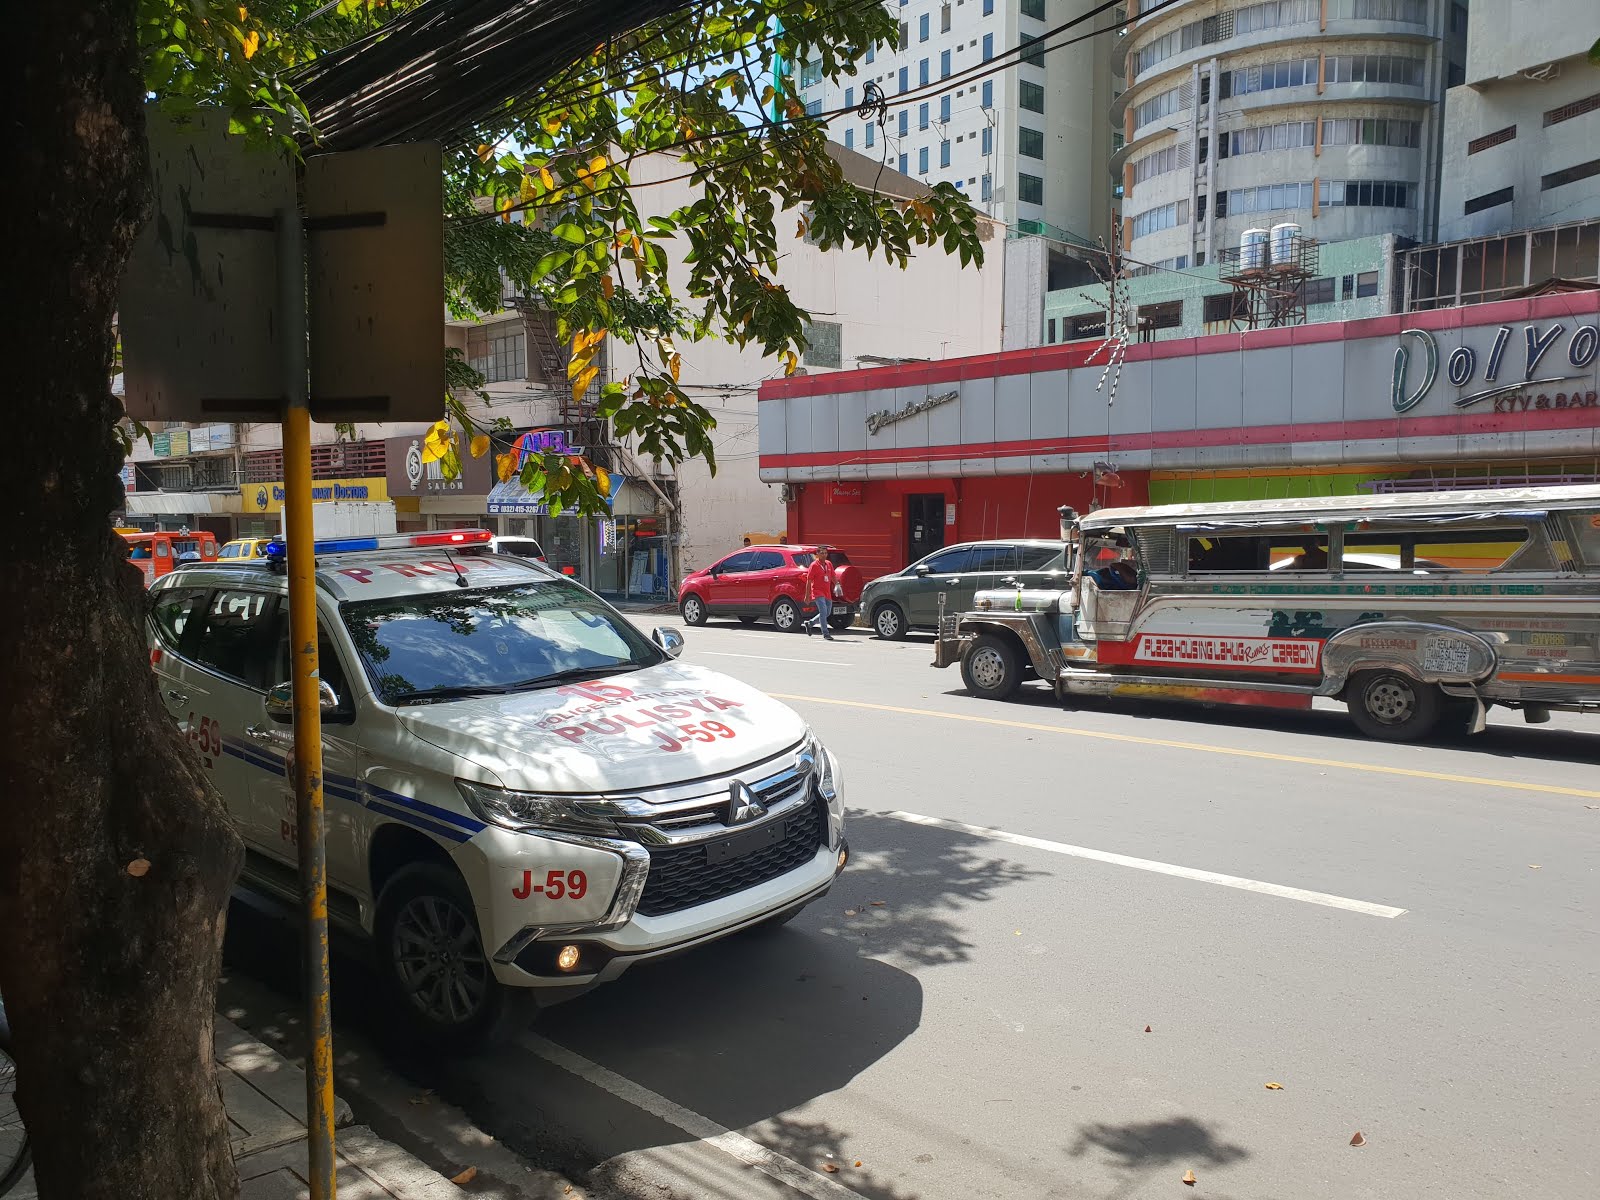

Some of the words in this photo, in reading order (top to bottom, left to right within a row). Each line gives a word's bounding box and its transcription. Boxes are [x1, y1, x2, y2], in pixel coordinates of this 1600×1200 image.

[1494, 395, 1532, 413] KTV
[1535, 393, 1551, 409] &
[1555, 391, 1598, 409] BAR
[428, 482, 463, 490] SALON
[555, 680, 634, 702] 15
[534, 702, 603, 729] POLICE
[551, 696, 744, 743] PULISYA
[653, 720, 736, 752] J-59
[512, 869, 587, 900] J-59
